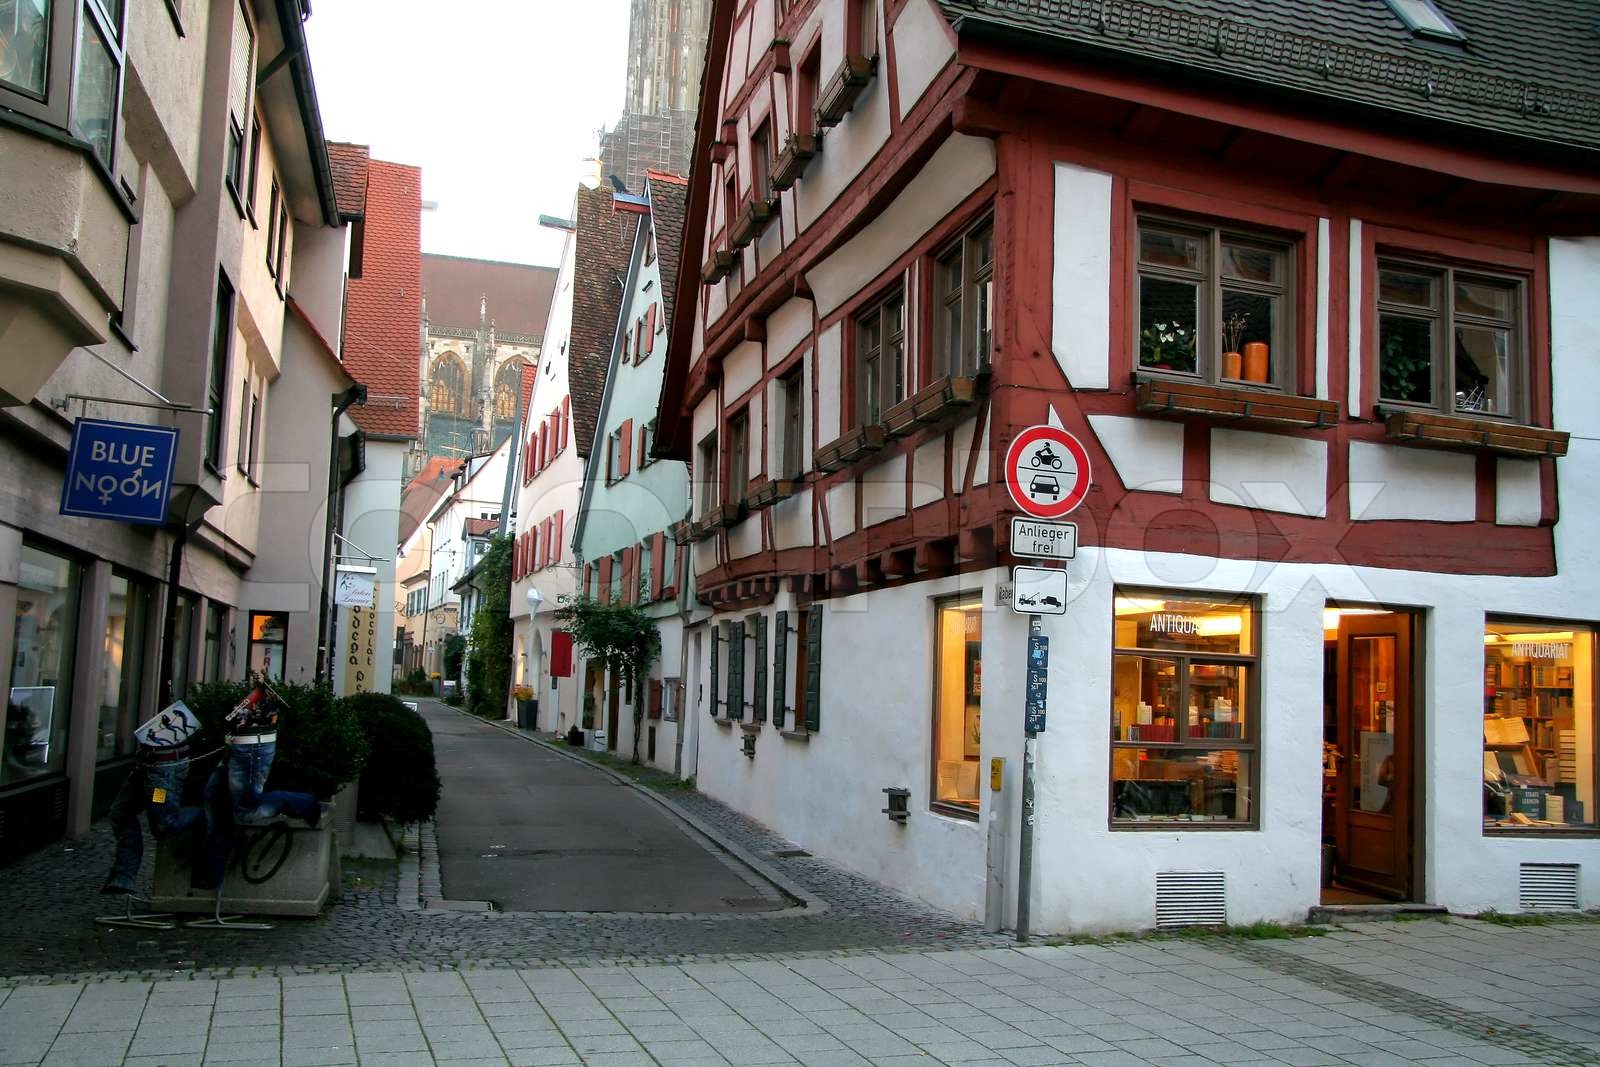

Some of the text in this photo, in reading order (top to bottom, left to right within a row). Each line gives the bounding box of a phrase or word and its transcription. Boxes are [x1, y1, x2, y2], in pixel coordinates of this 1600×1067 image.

[91, 440, 156, 467] BLUE
[1018, 524, 1070, 541] Anlieger
[1033, 540, 1054, 554] frei
[1511, 641, 1569, 659] ANTIQUARIAT
[1032, 674, 1038, 683] S
[1031, 705, 1037, 714] S
